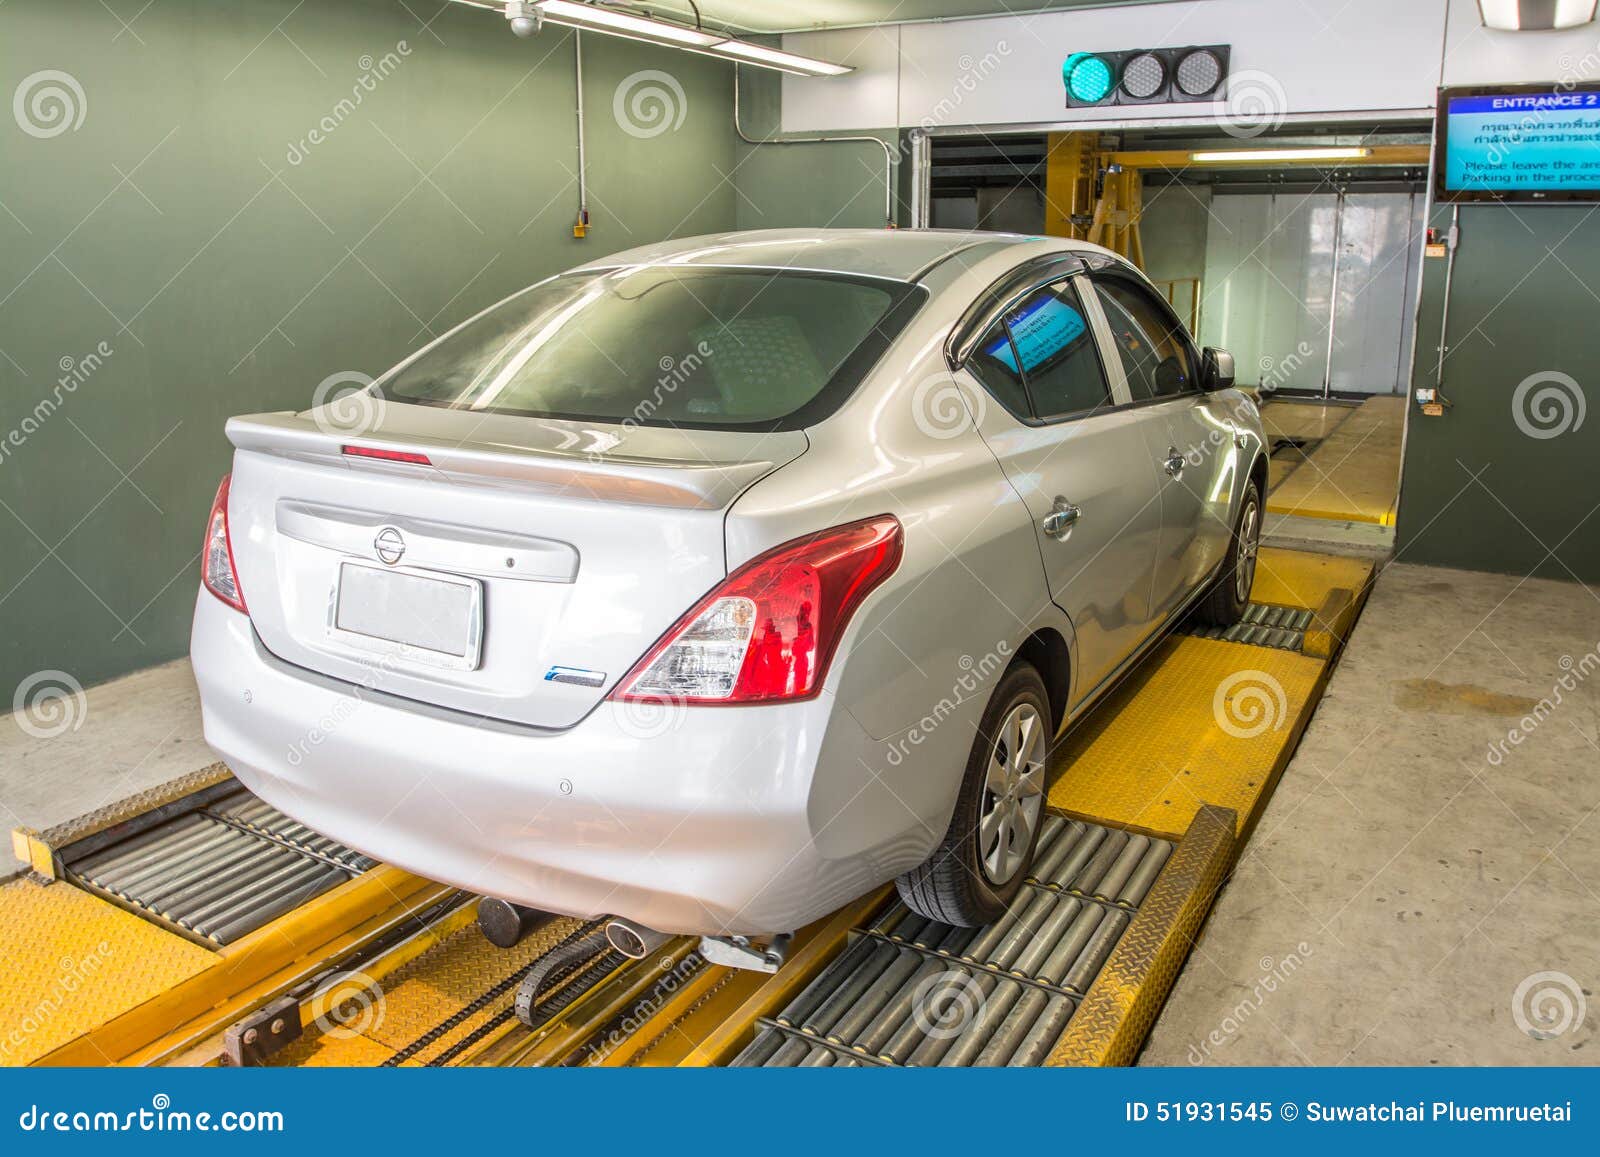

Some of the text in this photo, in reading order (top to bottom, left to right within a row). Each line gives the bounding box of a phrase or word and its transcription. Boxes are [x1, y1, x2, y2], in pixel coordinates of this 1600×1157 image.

[1492, 95, 1598, 109] ENTRANCE 2
[1465, 160, 1507, 170] Please
[1512, 160, 1548, 170] leave
[1553, 160, 1575, 169] the
[1462, 172, 1511, 183] Parking
[1516, 172, 1528, 182] in
[1533, 172, 1556, 182] the
